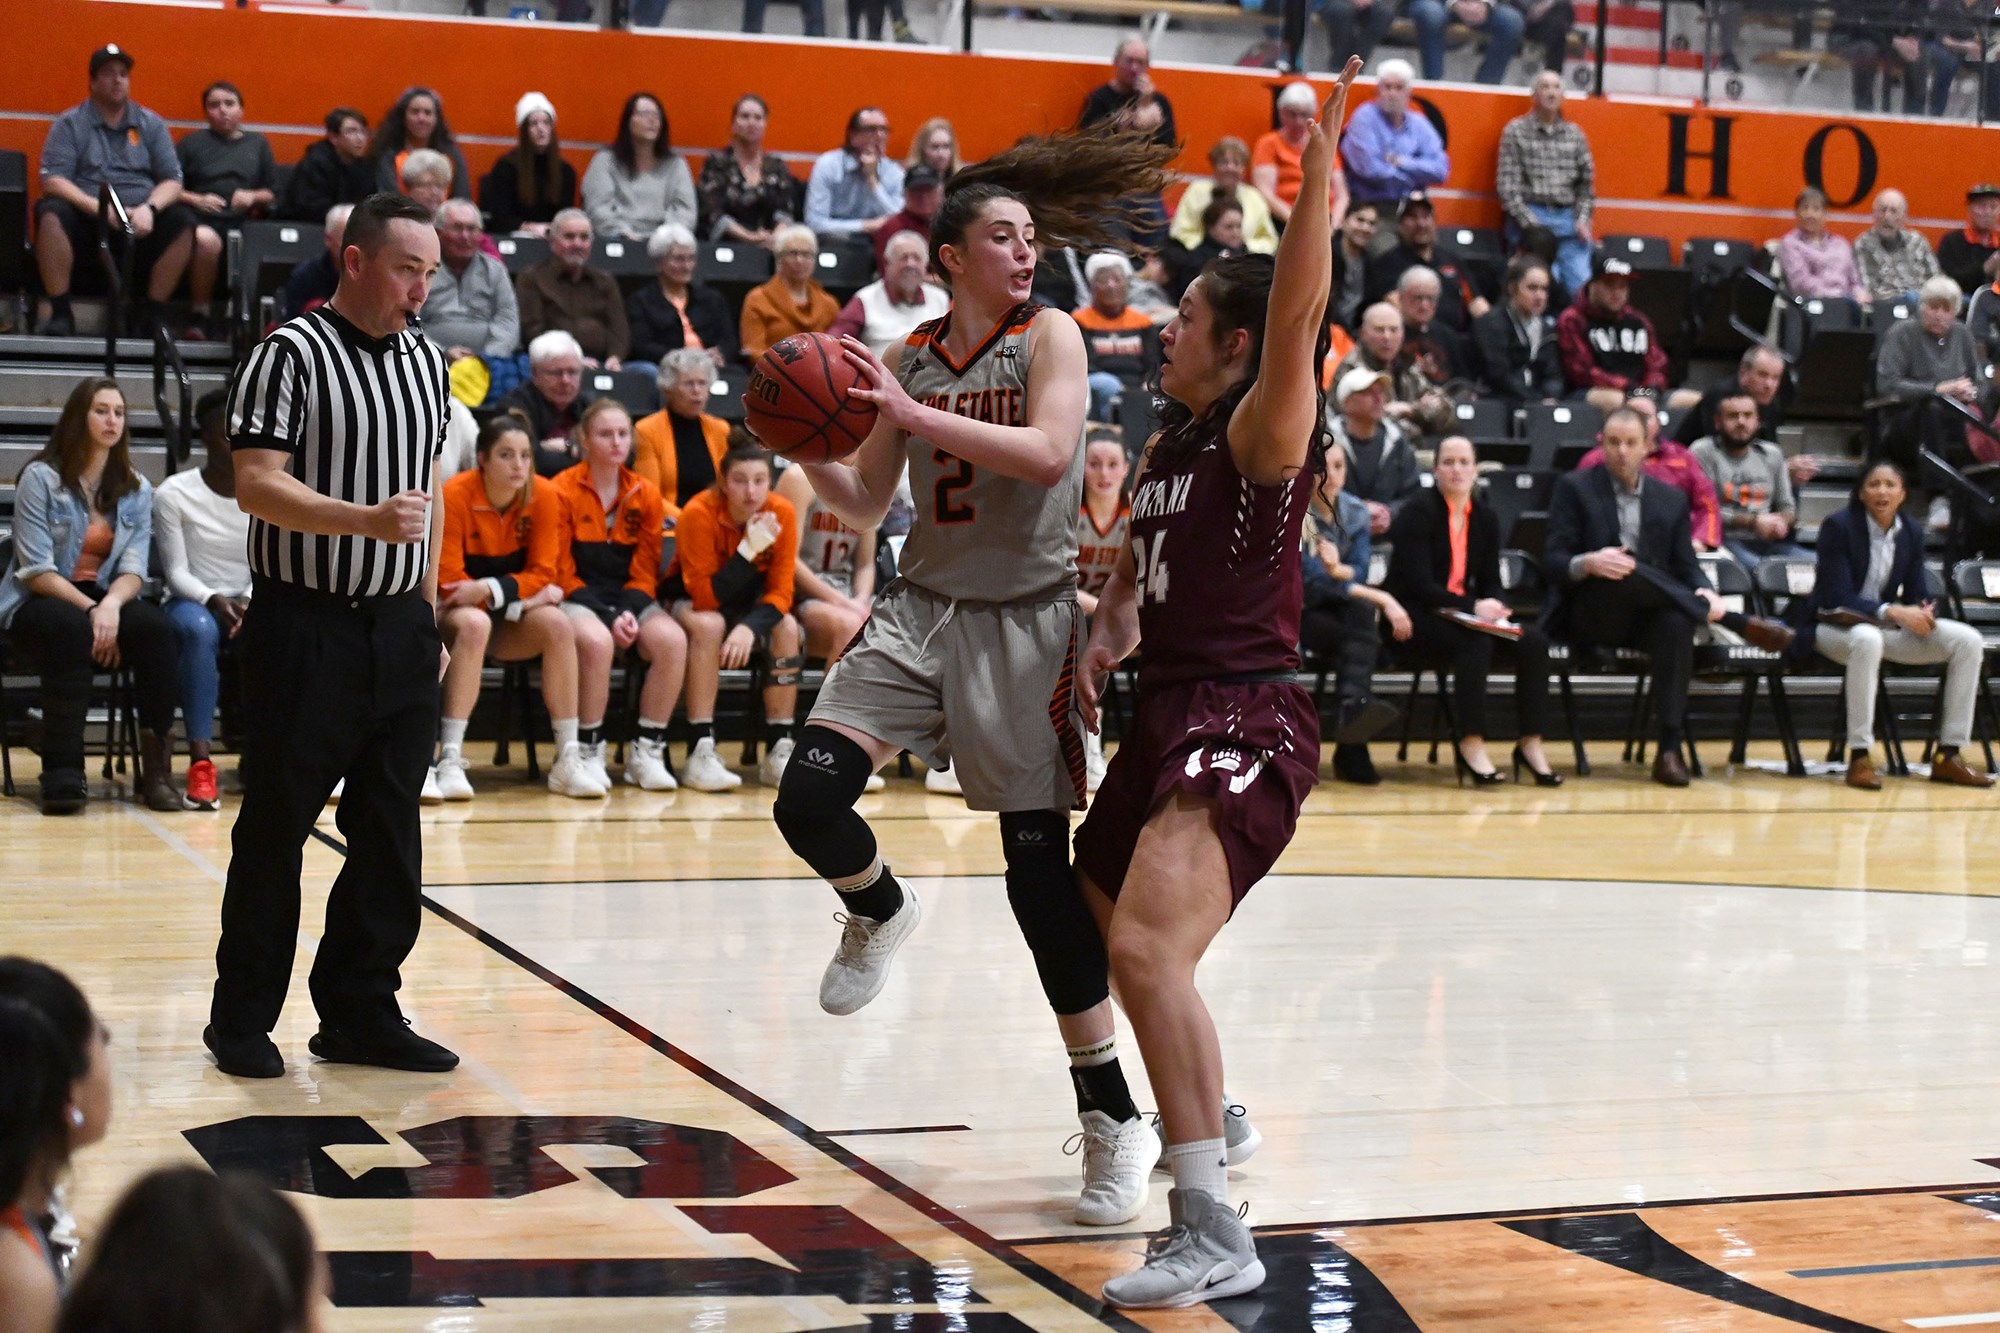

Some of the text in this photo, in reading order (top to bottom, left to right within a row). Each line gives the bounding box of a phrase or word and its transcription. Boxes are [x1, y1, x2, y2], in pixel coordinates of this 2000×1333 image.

[933, 447, 976, 526] 2
[1132, 473, 1194, 522] ONTANA
[1131, 528, 1169, 608] 24
